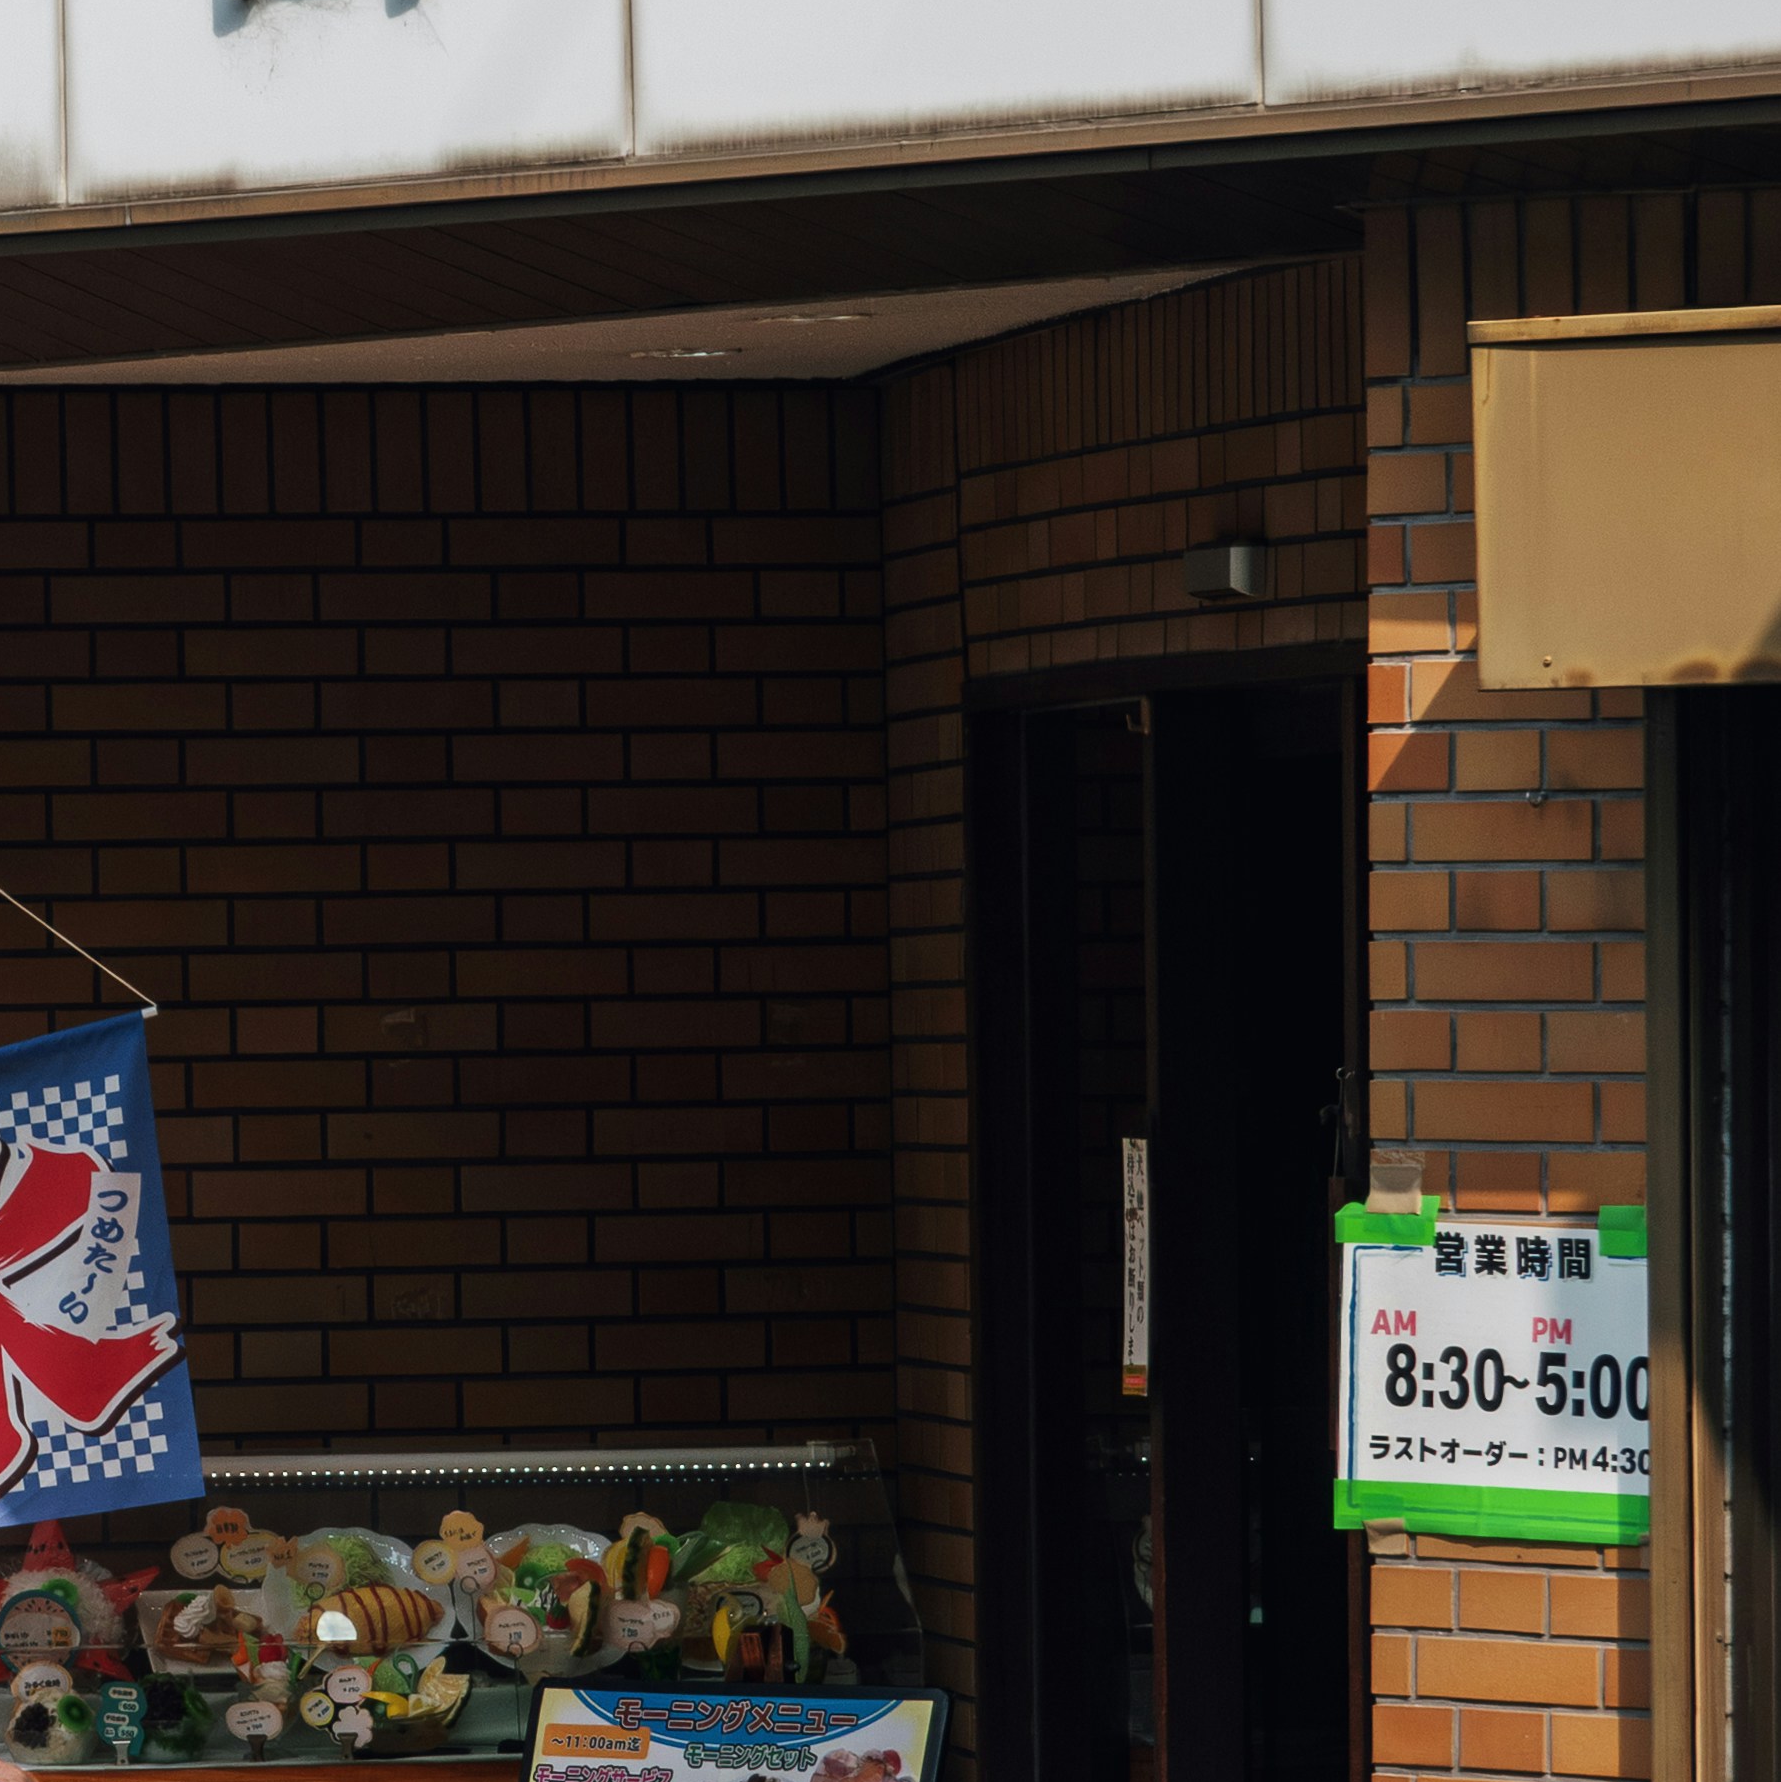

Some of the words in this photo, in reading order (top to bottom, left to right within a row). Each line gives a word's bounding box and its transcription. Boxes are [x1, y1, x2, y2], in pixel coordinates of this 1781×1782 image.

[1433, 1231, 1593, 1282] 営業時間
[1371, 1309, 1417, 1337] AM
[1531, 1317, 1572, 1345] PM
[615, 1699, 858, 1735] モーニングメニュー
[684, 1743, 818, 1771] モーニングセット
